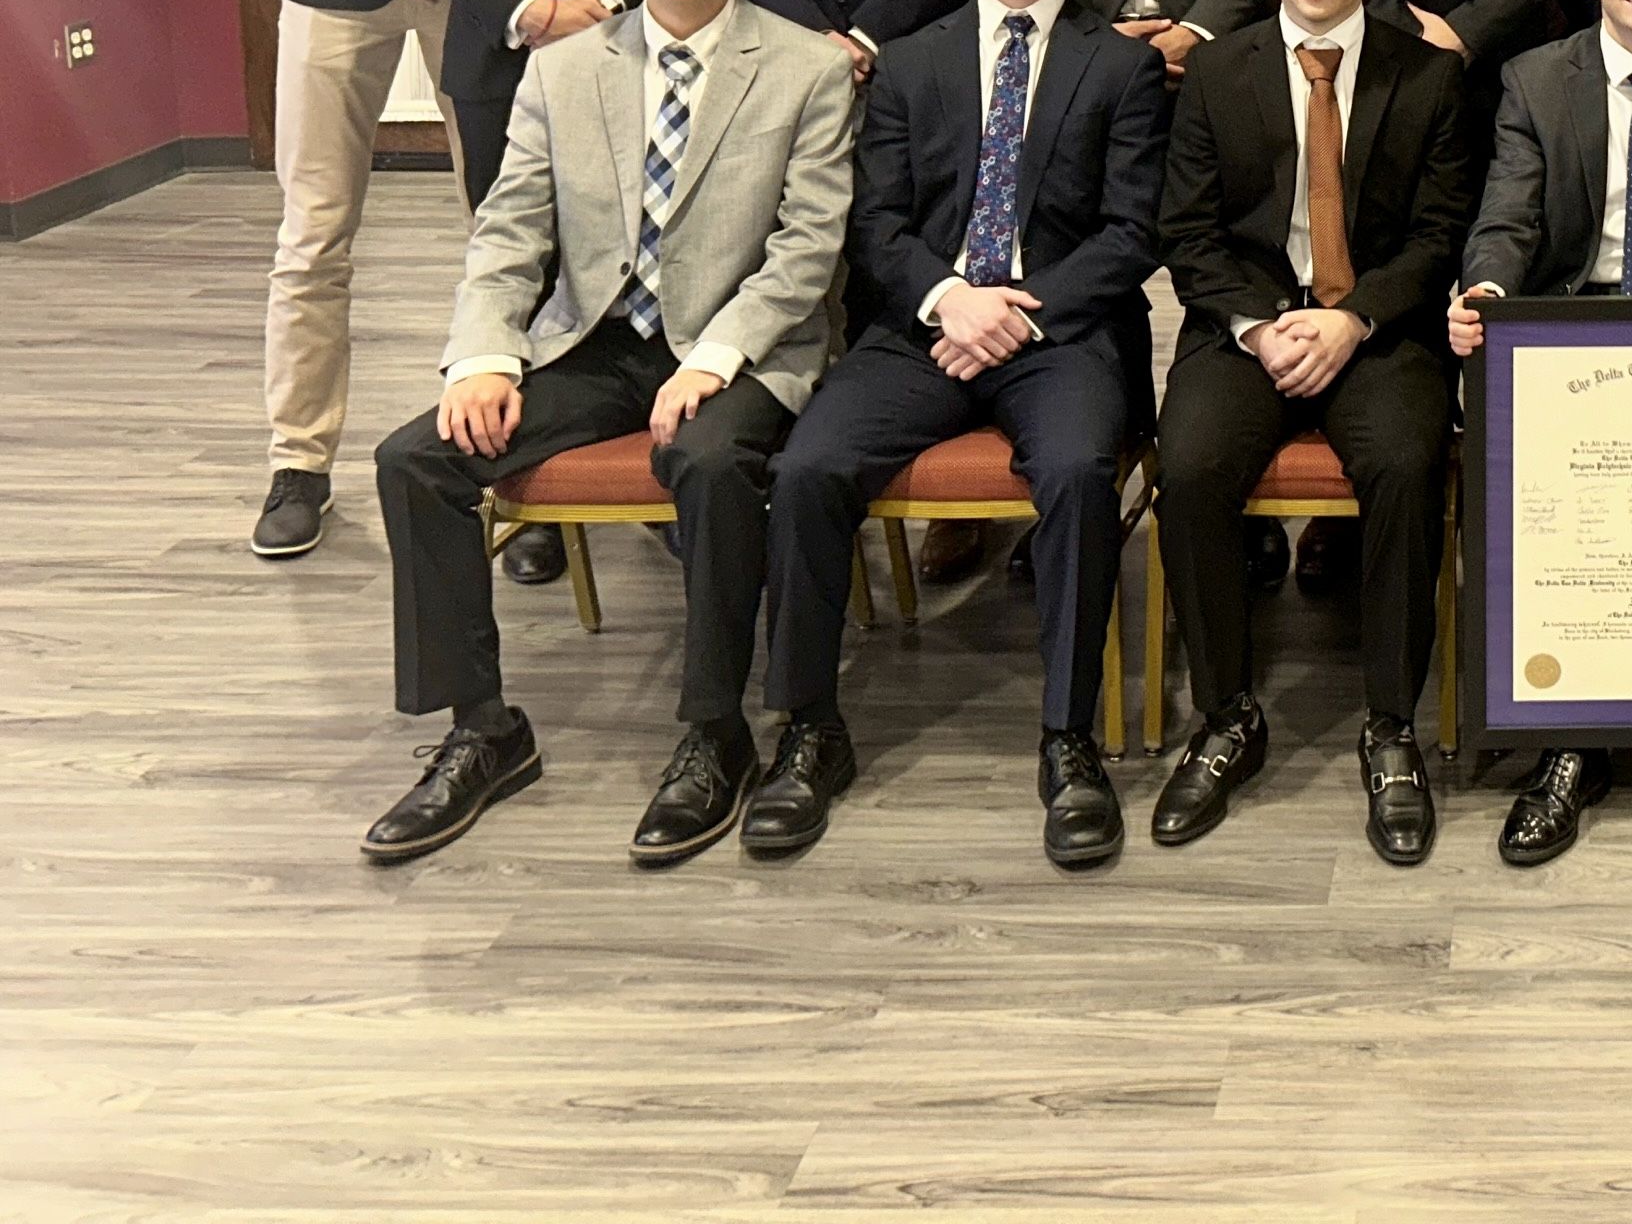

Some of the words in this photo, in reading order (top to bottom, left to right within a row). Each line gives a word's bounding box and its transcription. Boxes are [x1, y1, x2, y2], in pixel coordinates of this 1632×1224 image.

[1567, 377, 1591, 394] The
[1593, 368, 1624, 387] Delta
[1570, 462, 1594, 471] Virginia
